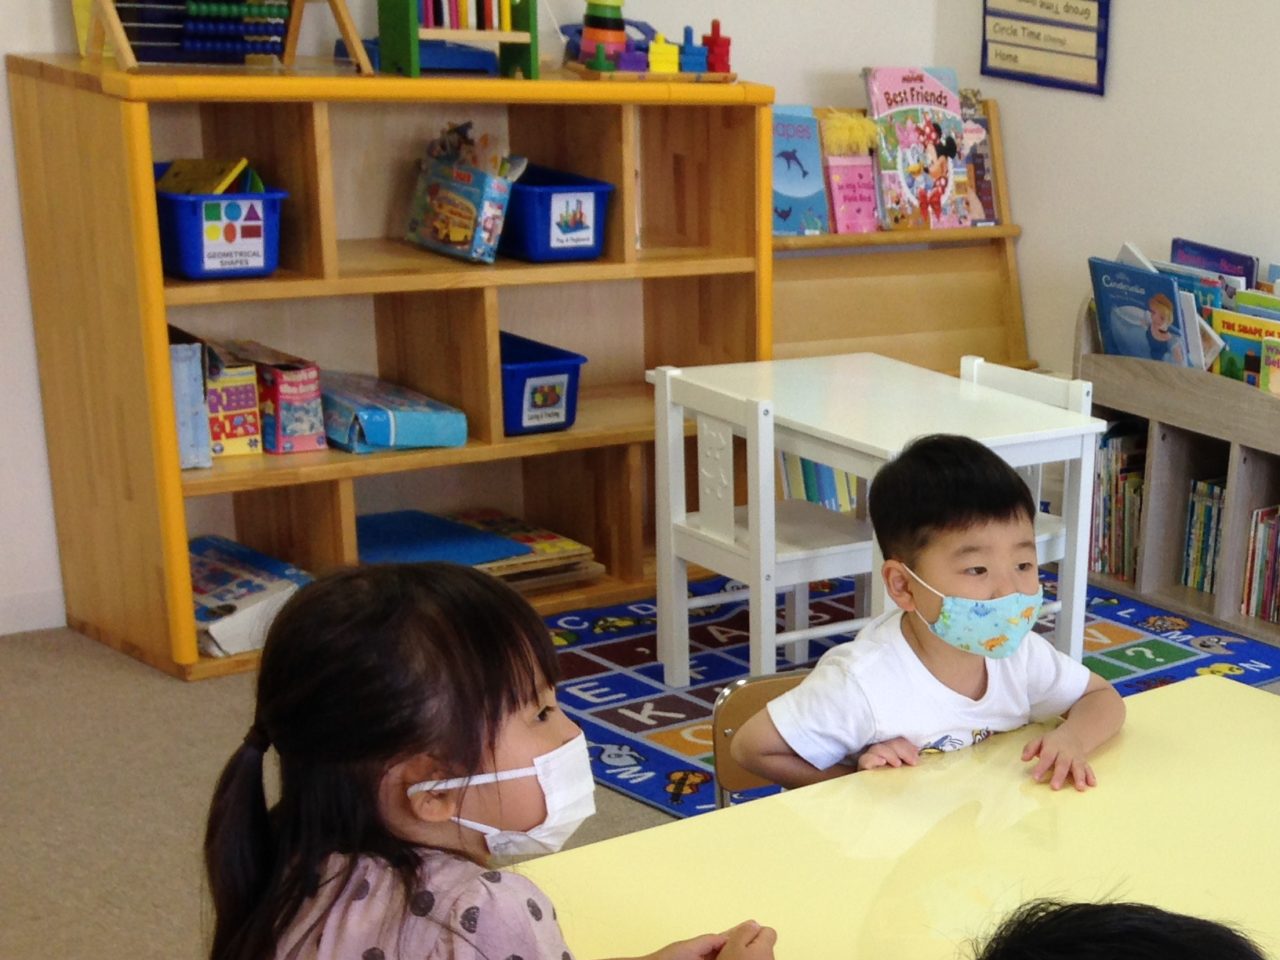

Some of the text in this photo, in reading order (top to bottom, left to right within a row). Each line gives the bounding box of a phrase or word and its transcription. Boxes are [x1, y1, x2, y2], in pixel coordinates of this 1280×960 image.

[884, 87, 948, 107] Best Friends
[772, 122, 812, 140] apes
[207, 250, 261, 259] GEOMETRICAL
[1238, 324, 1262, 337] SHAPE
[565, 682, 627, 703] E
[617, 702, 686, 725] K
